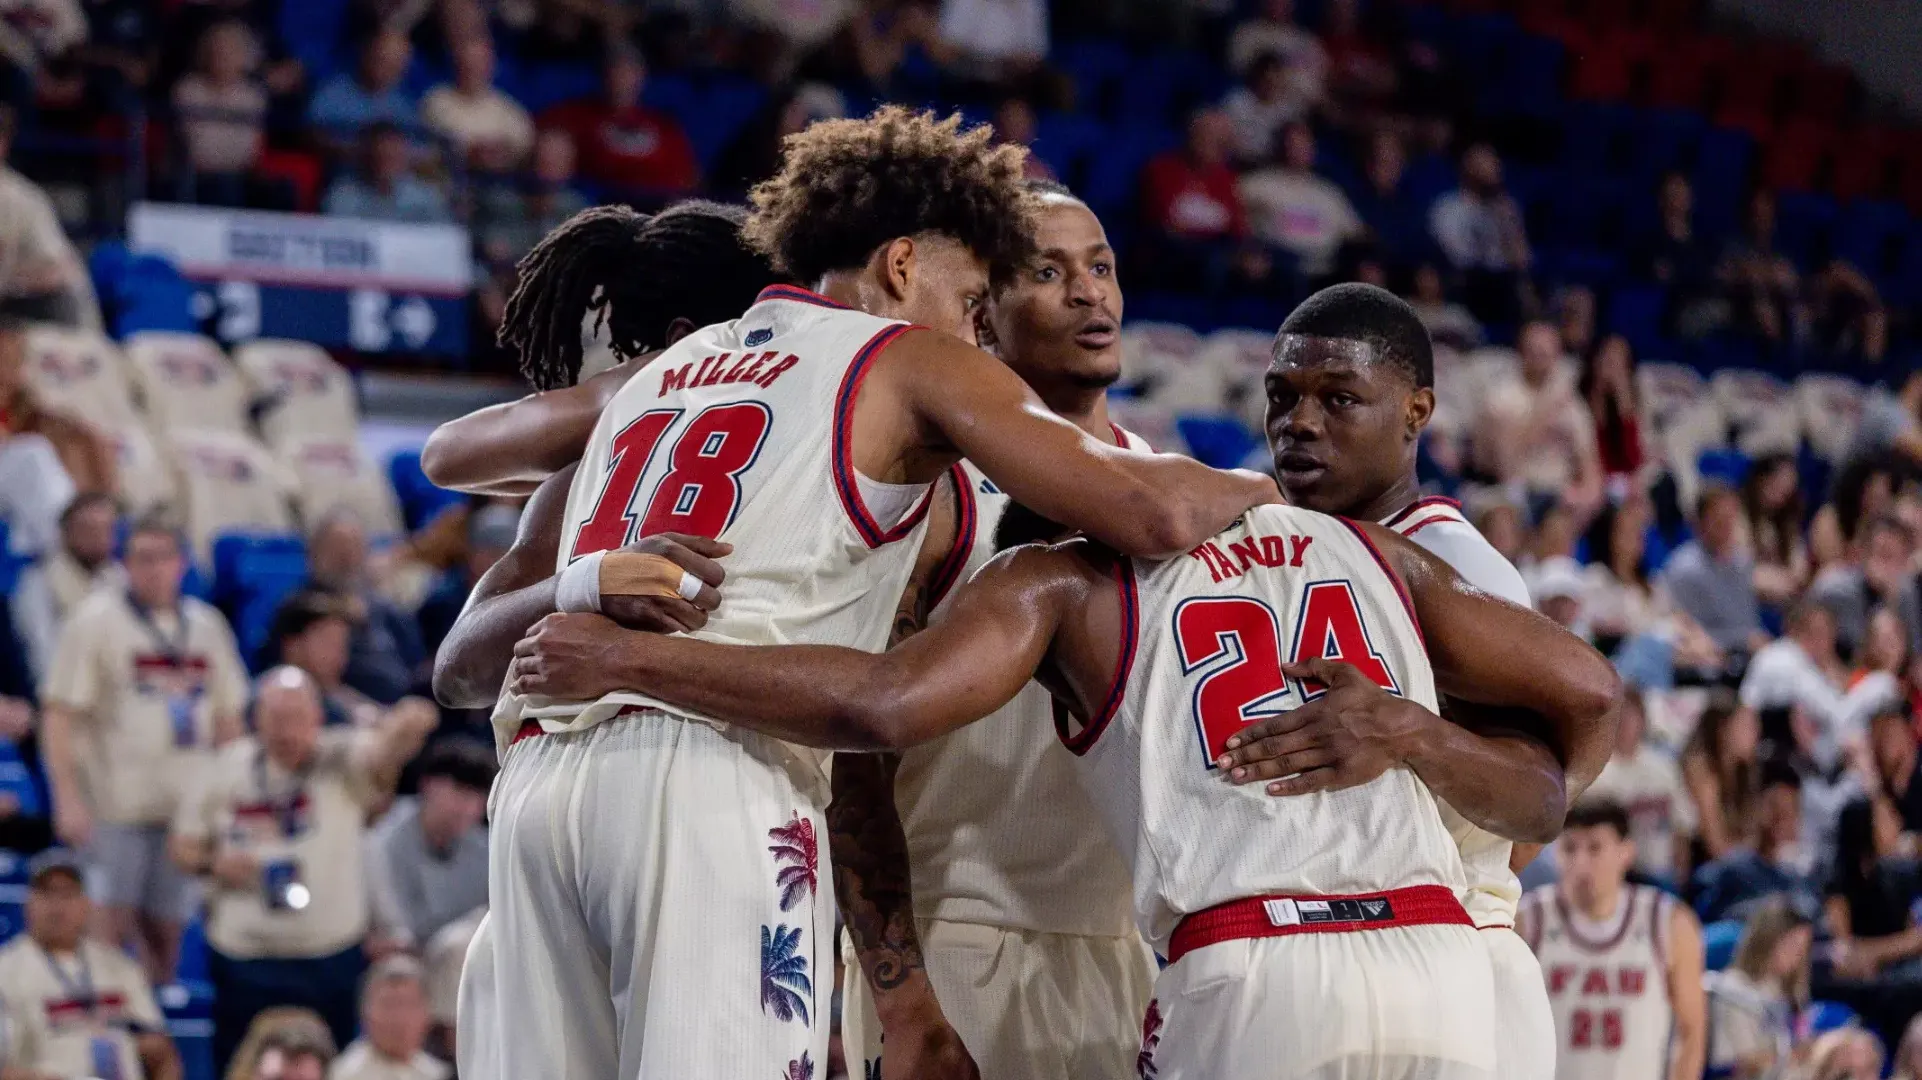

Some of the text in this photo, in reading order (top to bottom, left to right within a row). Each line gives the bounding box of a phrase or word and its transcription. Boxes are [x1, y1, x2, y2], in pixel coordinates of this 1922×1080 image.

[657, 350, 800, 399] MILLER
[567, 399, 774, 567] 18
[1187, 534, 1314, 584] TANDY
[1171, 578, 1404, 771] 24
[1549, 962, 1647, 998] FAU
